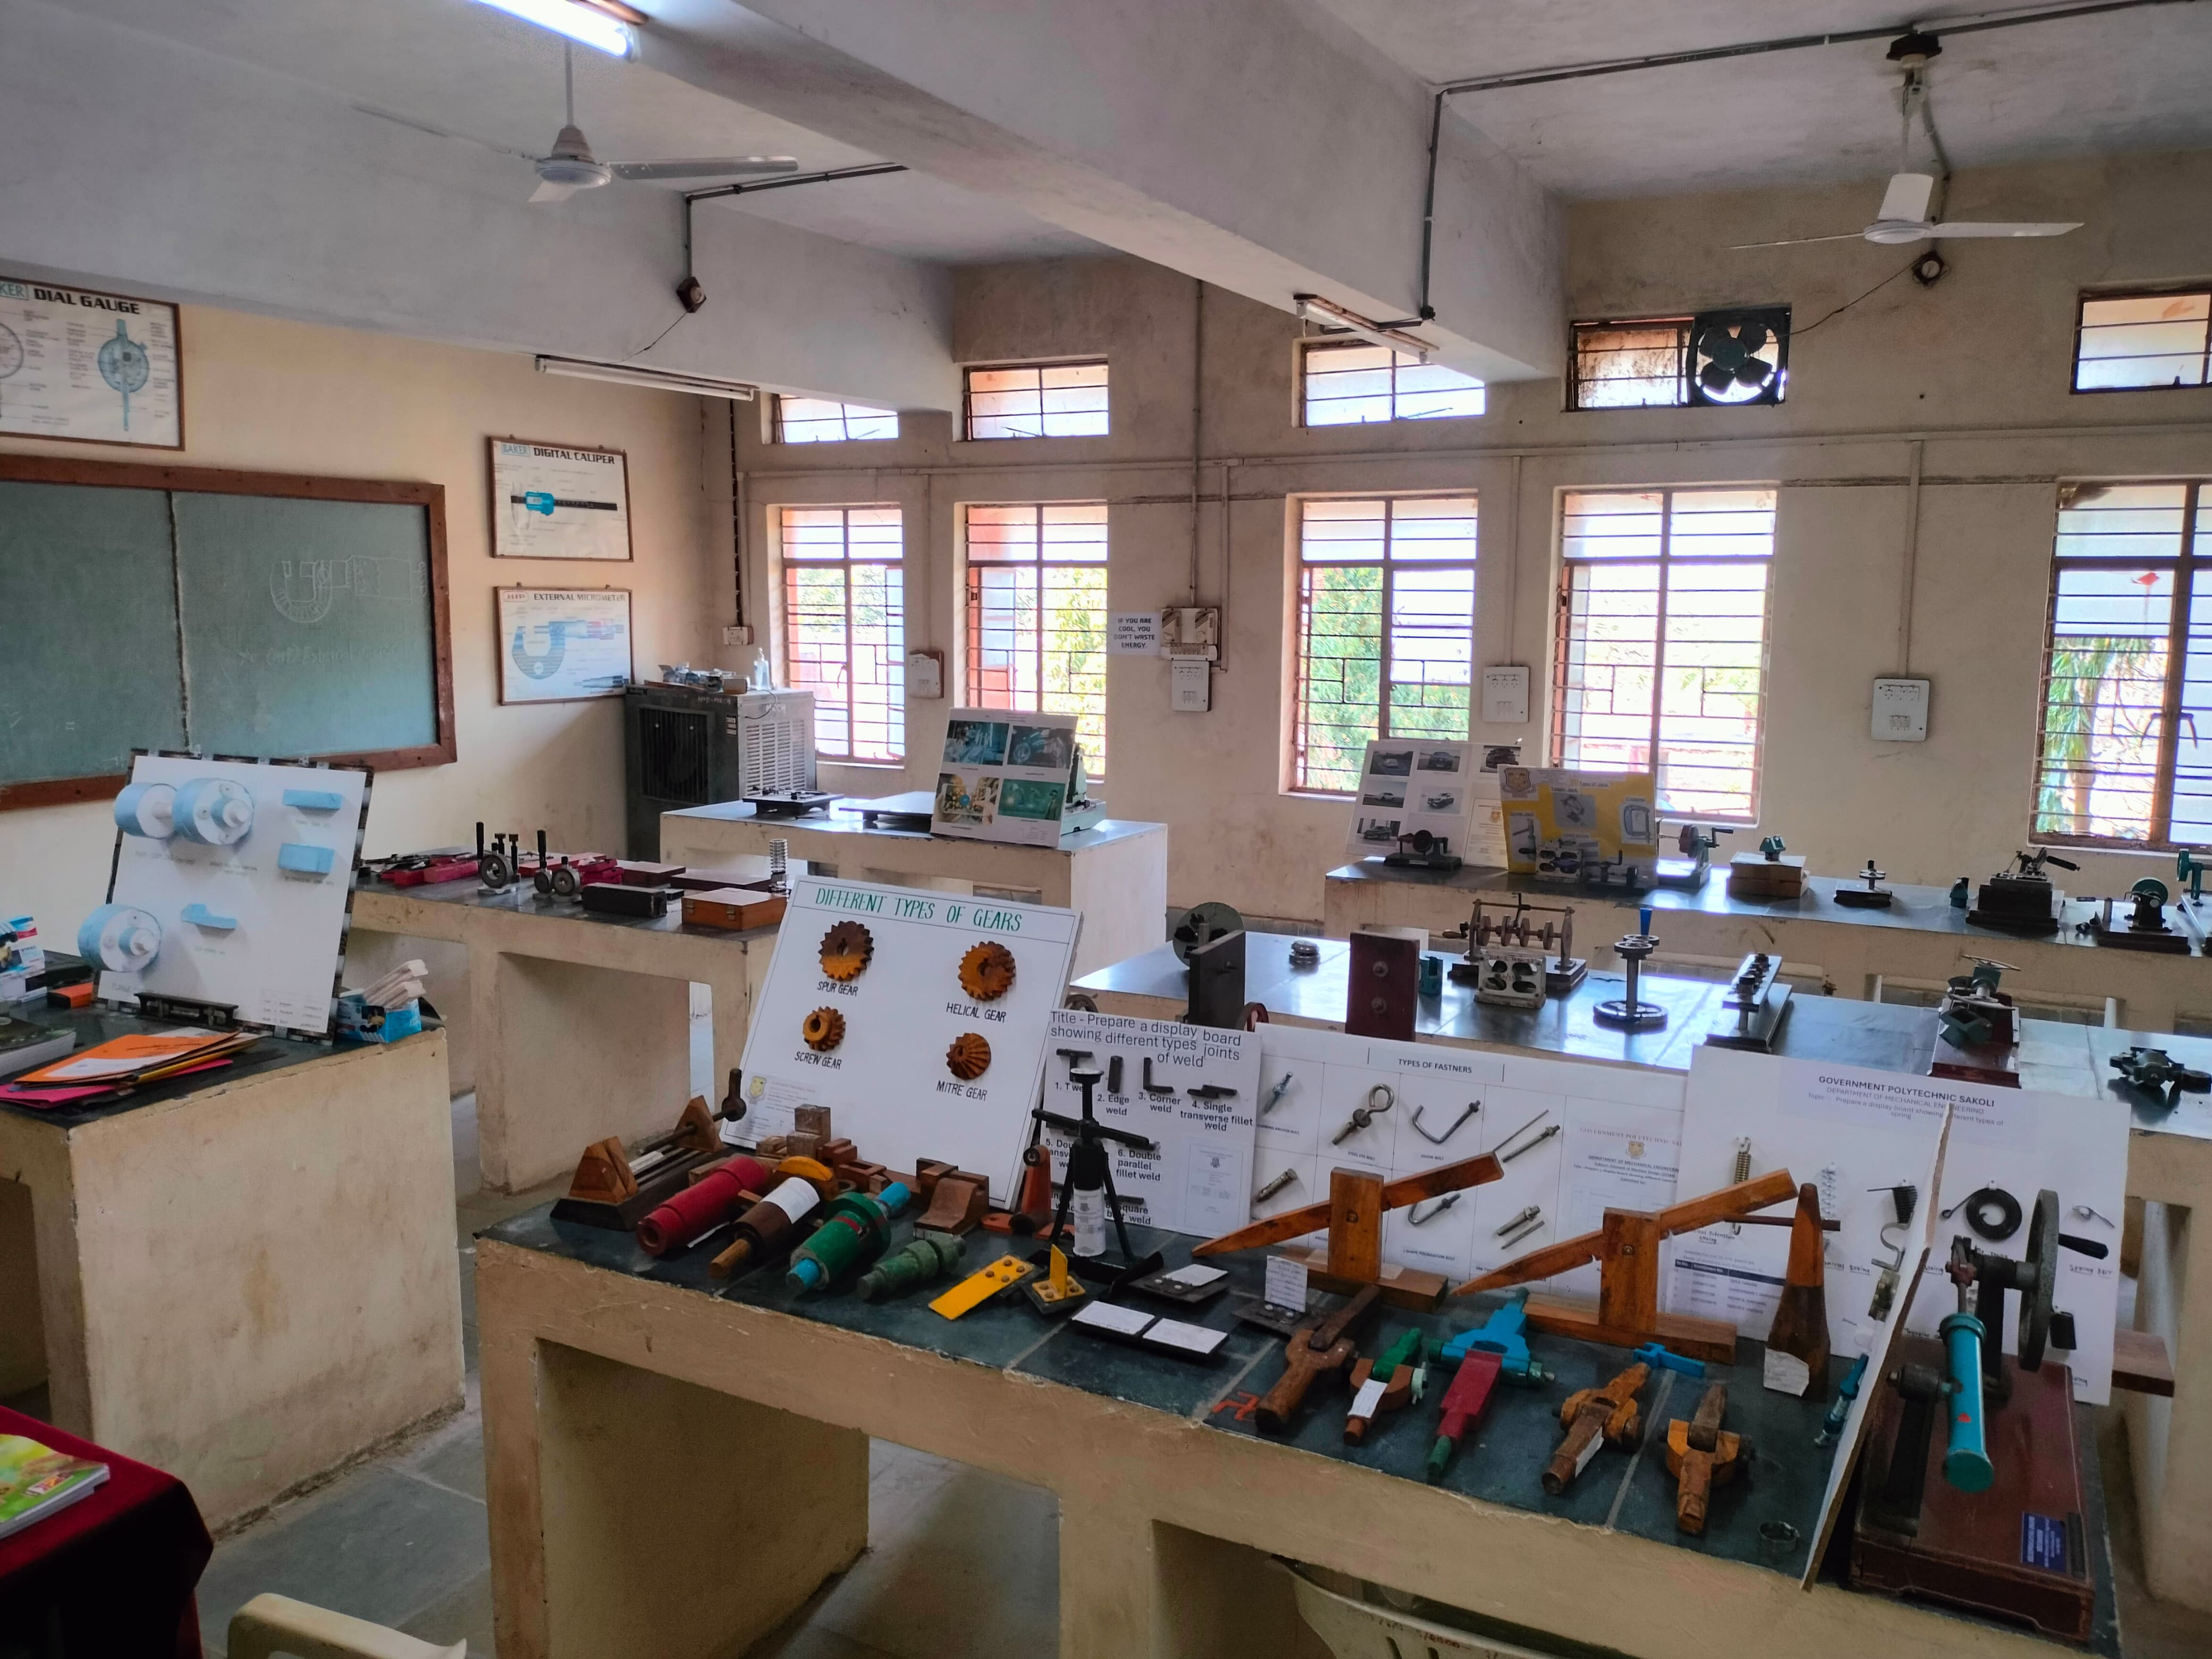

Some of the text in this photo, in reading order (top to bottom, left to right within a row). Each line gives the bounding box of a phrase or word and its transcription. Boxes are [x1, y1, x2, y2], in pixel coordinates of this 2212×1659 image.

[34, 288, 140, 315] DIAL GAUGE
[502, 444, 527, 455] BAKER
[533, 447, 615, 464] DIGITAL CALIPER
[815, 887, 1023, 932] DIFFERENT TYPES OF GEARS
[817, 982, 858, 996] SPUR GEAR
[946, 1002, 1007, 1023] HELICAL GEAR
[1051, 1011, 1077, 1024] Title
[1087, 1013, 1136, 1033] Prepare
[1141, 1023, 1148, 1032] a
[1151, 1021, 1197, 1040] display
[1203, 1030, 1241, 1046] board
[1051, 1027, 1240, 1061] showing different types joints
[794, 1051, 842, 1070] SCREW GEAR
[1157, 1052, 1204, 1068] of weld
[1398, 1059, 1420, 1068] TYPES
[1435, 1063, 1472, 1073] FASTNERS
[936, 1080, 987, 1101] MITRE GEAR
[1055, 1082, 1062, 1090] 1.
[1819, 1076, 1995, 1107] GOVERNMENT POLYTECHNIC SAKOLI
[1108, 1095, 1129, 1105] Edge
[1150, 1094, 1181, 1105] Corner
[1826, 1087, 1872, 1099] DEPARTMENT
[1885, 1095, 1933, 1108] MECHANICAL
[1106, 1107, 1127, 1116] weld
[1150, 1104, 1172, 1113] weld
[1192, 1101, 1233, 1115] 4. Single
[1836, 1097, 1862, 1106] Prepare
[1869, 1102, 1892, 1110] display
[1915, 1109, 1943, 1118] showing
[1180, 1110, 1253, 1126] transverse fillet
[1891, 1112, 1911, 1120] spring
[1204, 1122, 1227, 1132] weld
[1129, 1150, 1161, 1161] Double
[1118, 1160, 1152, 1171] parallel
[1116, 1169, 1161, 1182] fillet weld
[1129, 1216, 1151, 1225] weld
